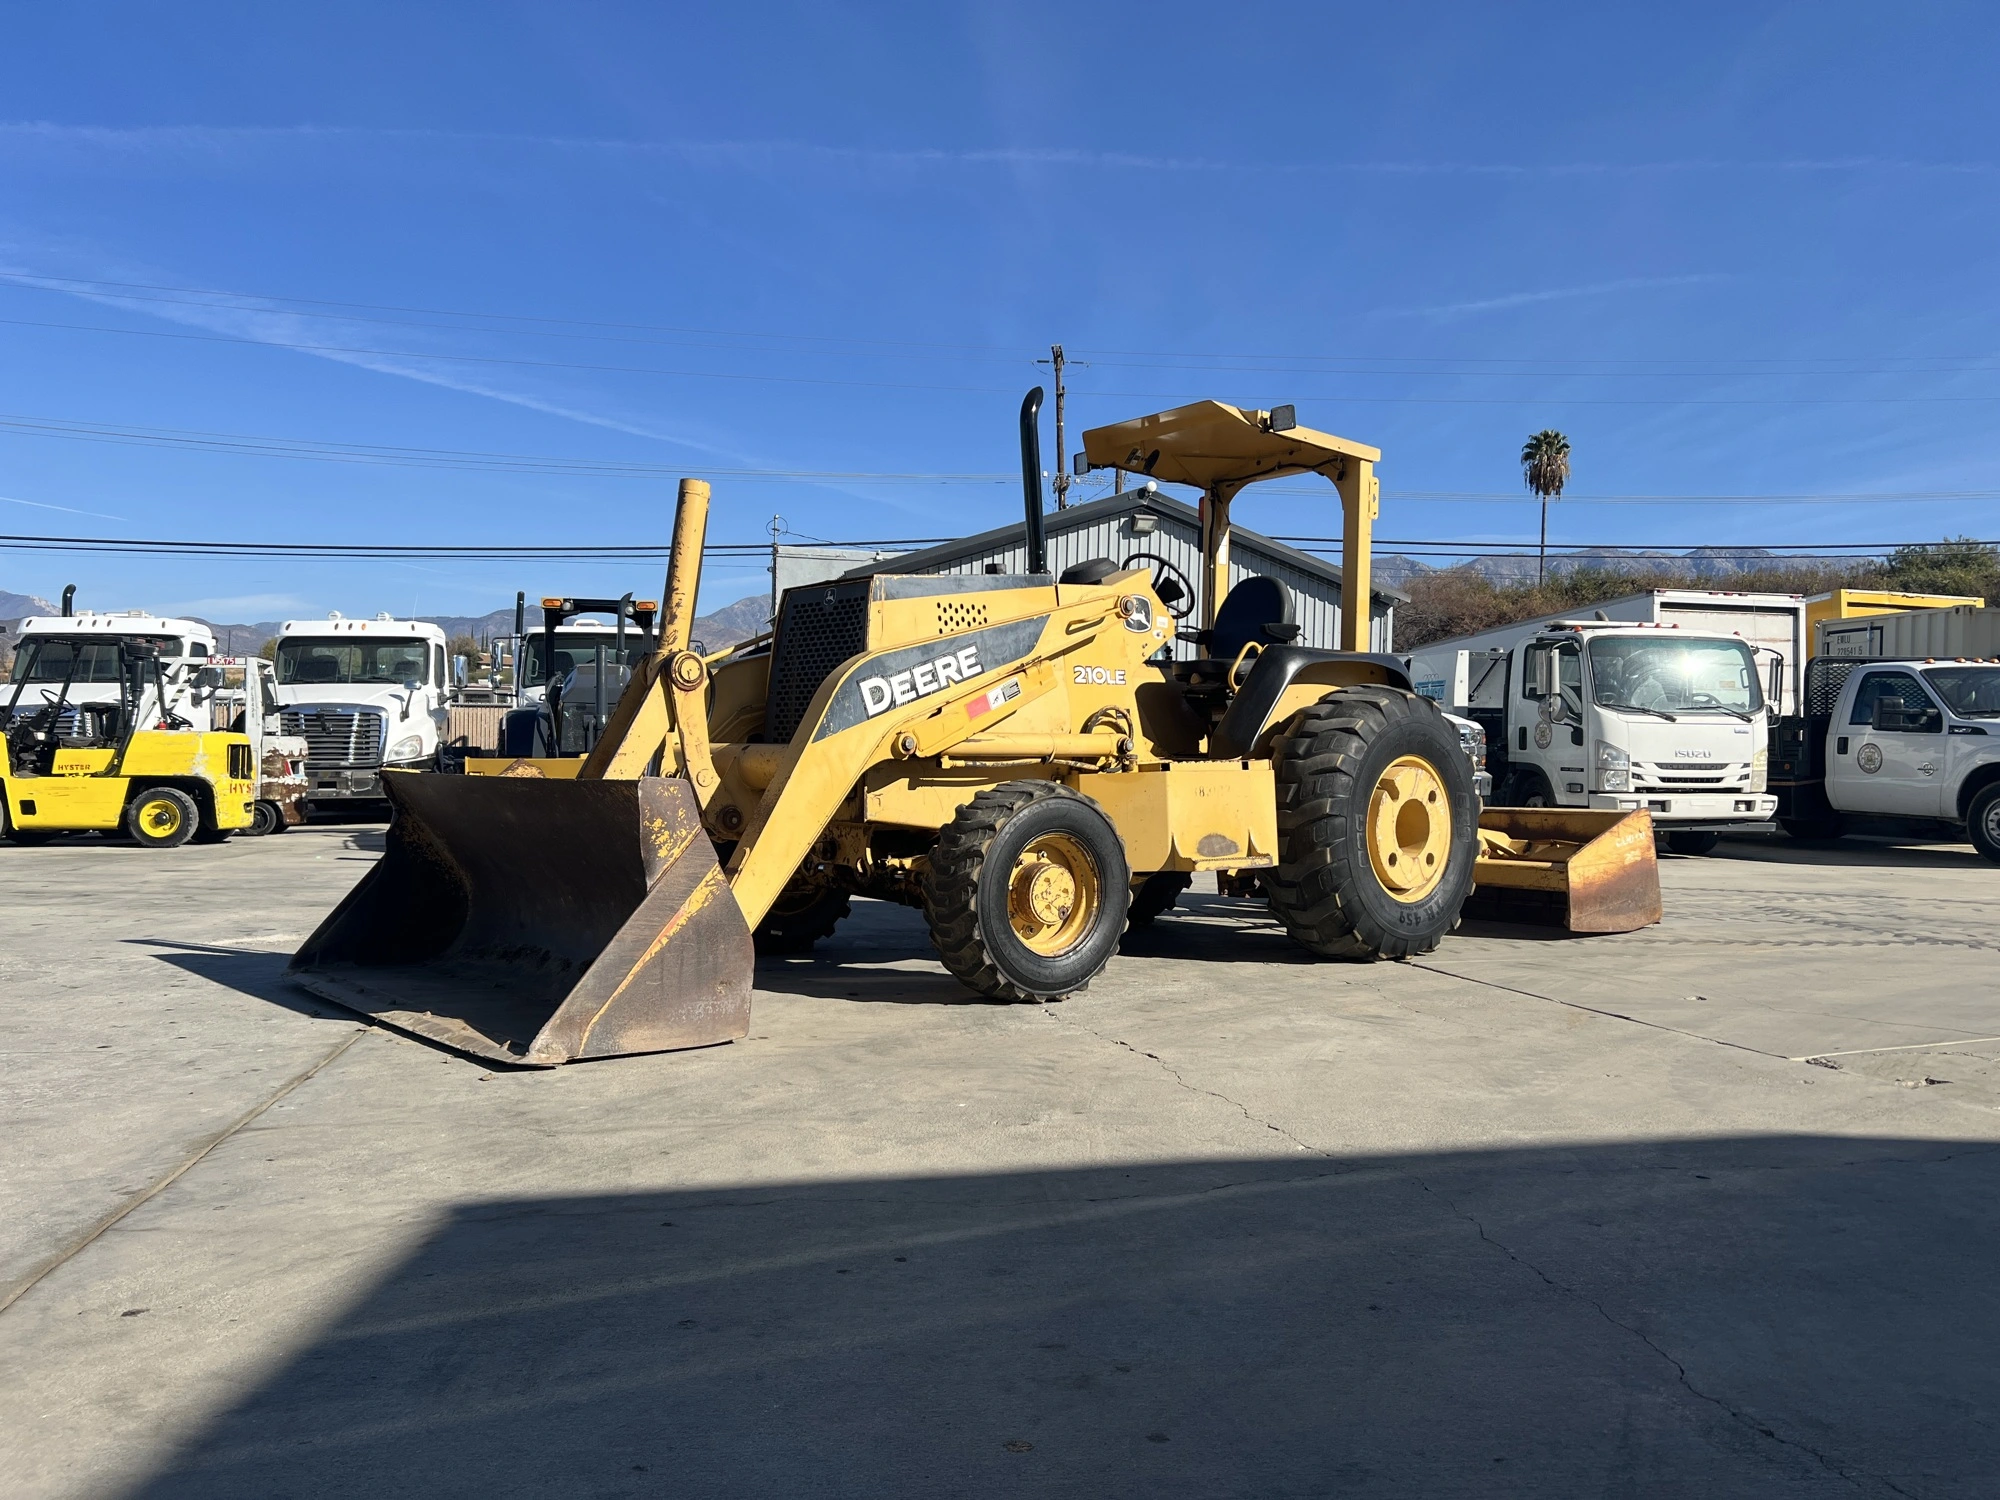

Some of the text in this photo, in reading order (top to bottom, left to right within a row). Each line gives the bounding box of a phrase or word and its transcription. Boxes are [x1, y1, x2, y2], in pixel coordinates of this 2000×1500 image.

[859, 645, 982, 716] DEERE
[1073, 665, 1126, 685] 210LE
[1674, 749, 1711, 759] ISUZU
[1399, 911, 1422, 927] 459
